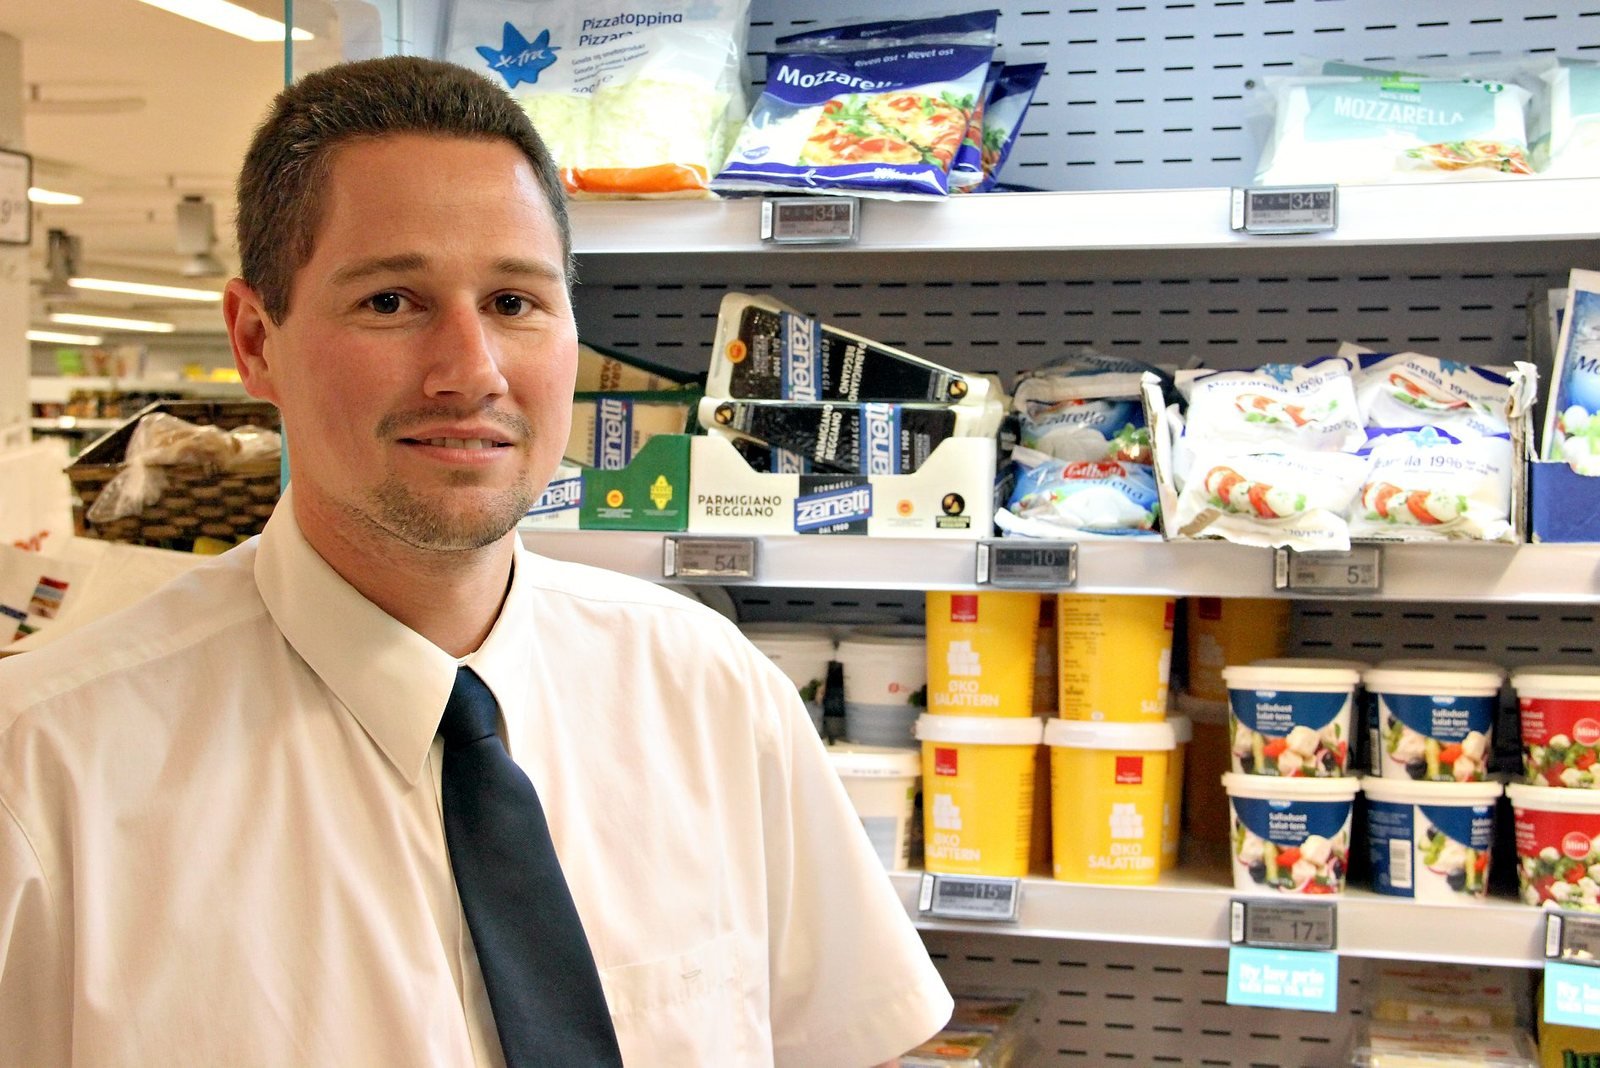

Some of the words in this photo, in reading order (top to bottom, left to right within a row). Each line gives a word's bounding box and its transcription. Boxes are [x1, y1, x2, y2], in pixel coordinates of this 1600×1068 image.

[1334, 96, 1464, 126] MOZZARELLA
[816, 205, 836, 220] 34
[1293, 194, 1314, 209] 34
[791, 315, 816, 401] zanett
[839, 345, 856, 395] REGGIANO
[609, 363, 623, 389] GRA
[848, 342, 867, 402] PARMIGIANO
[1406, 360, 1443, 385] arella
[600, 398, 623, 470] anetti
[815, 404, 834, 463] PARMIGIANO
[825, 411, 843, 461] REGGIANO
[851, 415, 860, 468] FORMAGGI
[865, 403, 889, 474] anett
[1430, 456, 1462, 469] 19%
[538, 482, 581, 506] netti
[698, 495, 782, 506] PARMIGIANO
[797, 490, 870, 521] zanetti
[706, 507, 774, 518] REGGIANO
[715, 555, 737, 571] 54
[1036, 551, 1055, 566] 10
[1347, 566, 1359, 584] 5
[1565, 840, 1589, 851] Mini
[980, 884, 998, 898] 15
[1290, 921, 1313, 941] 17
